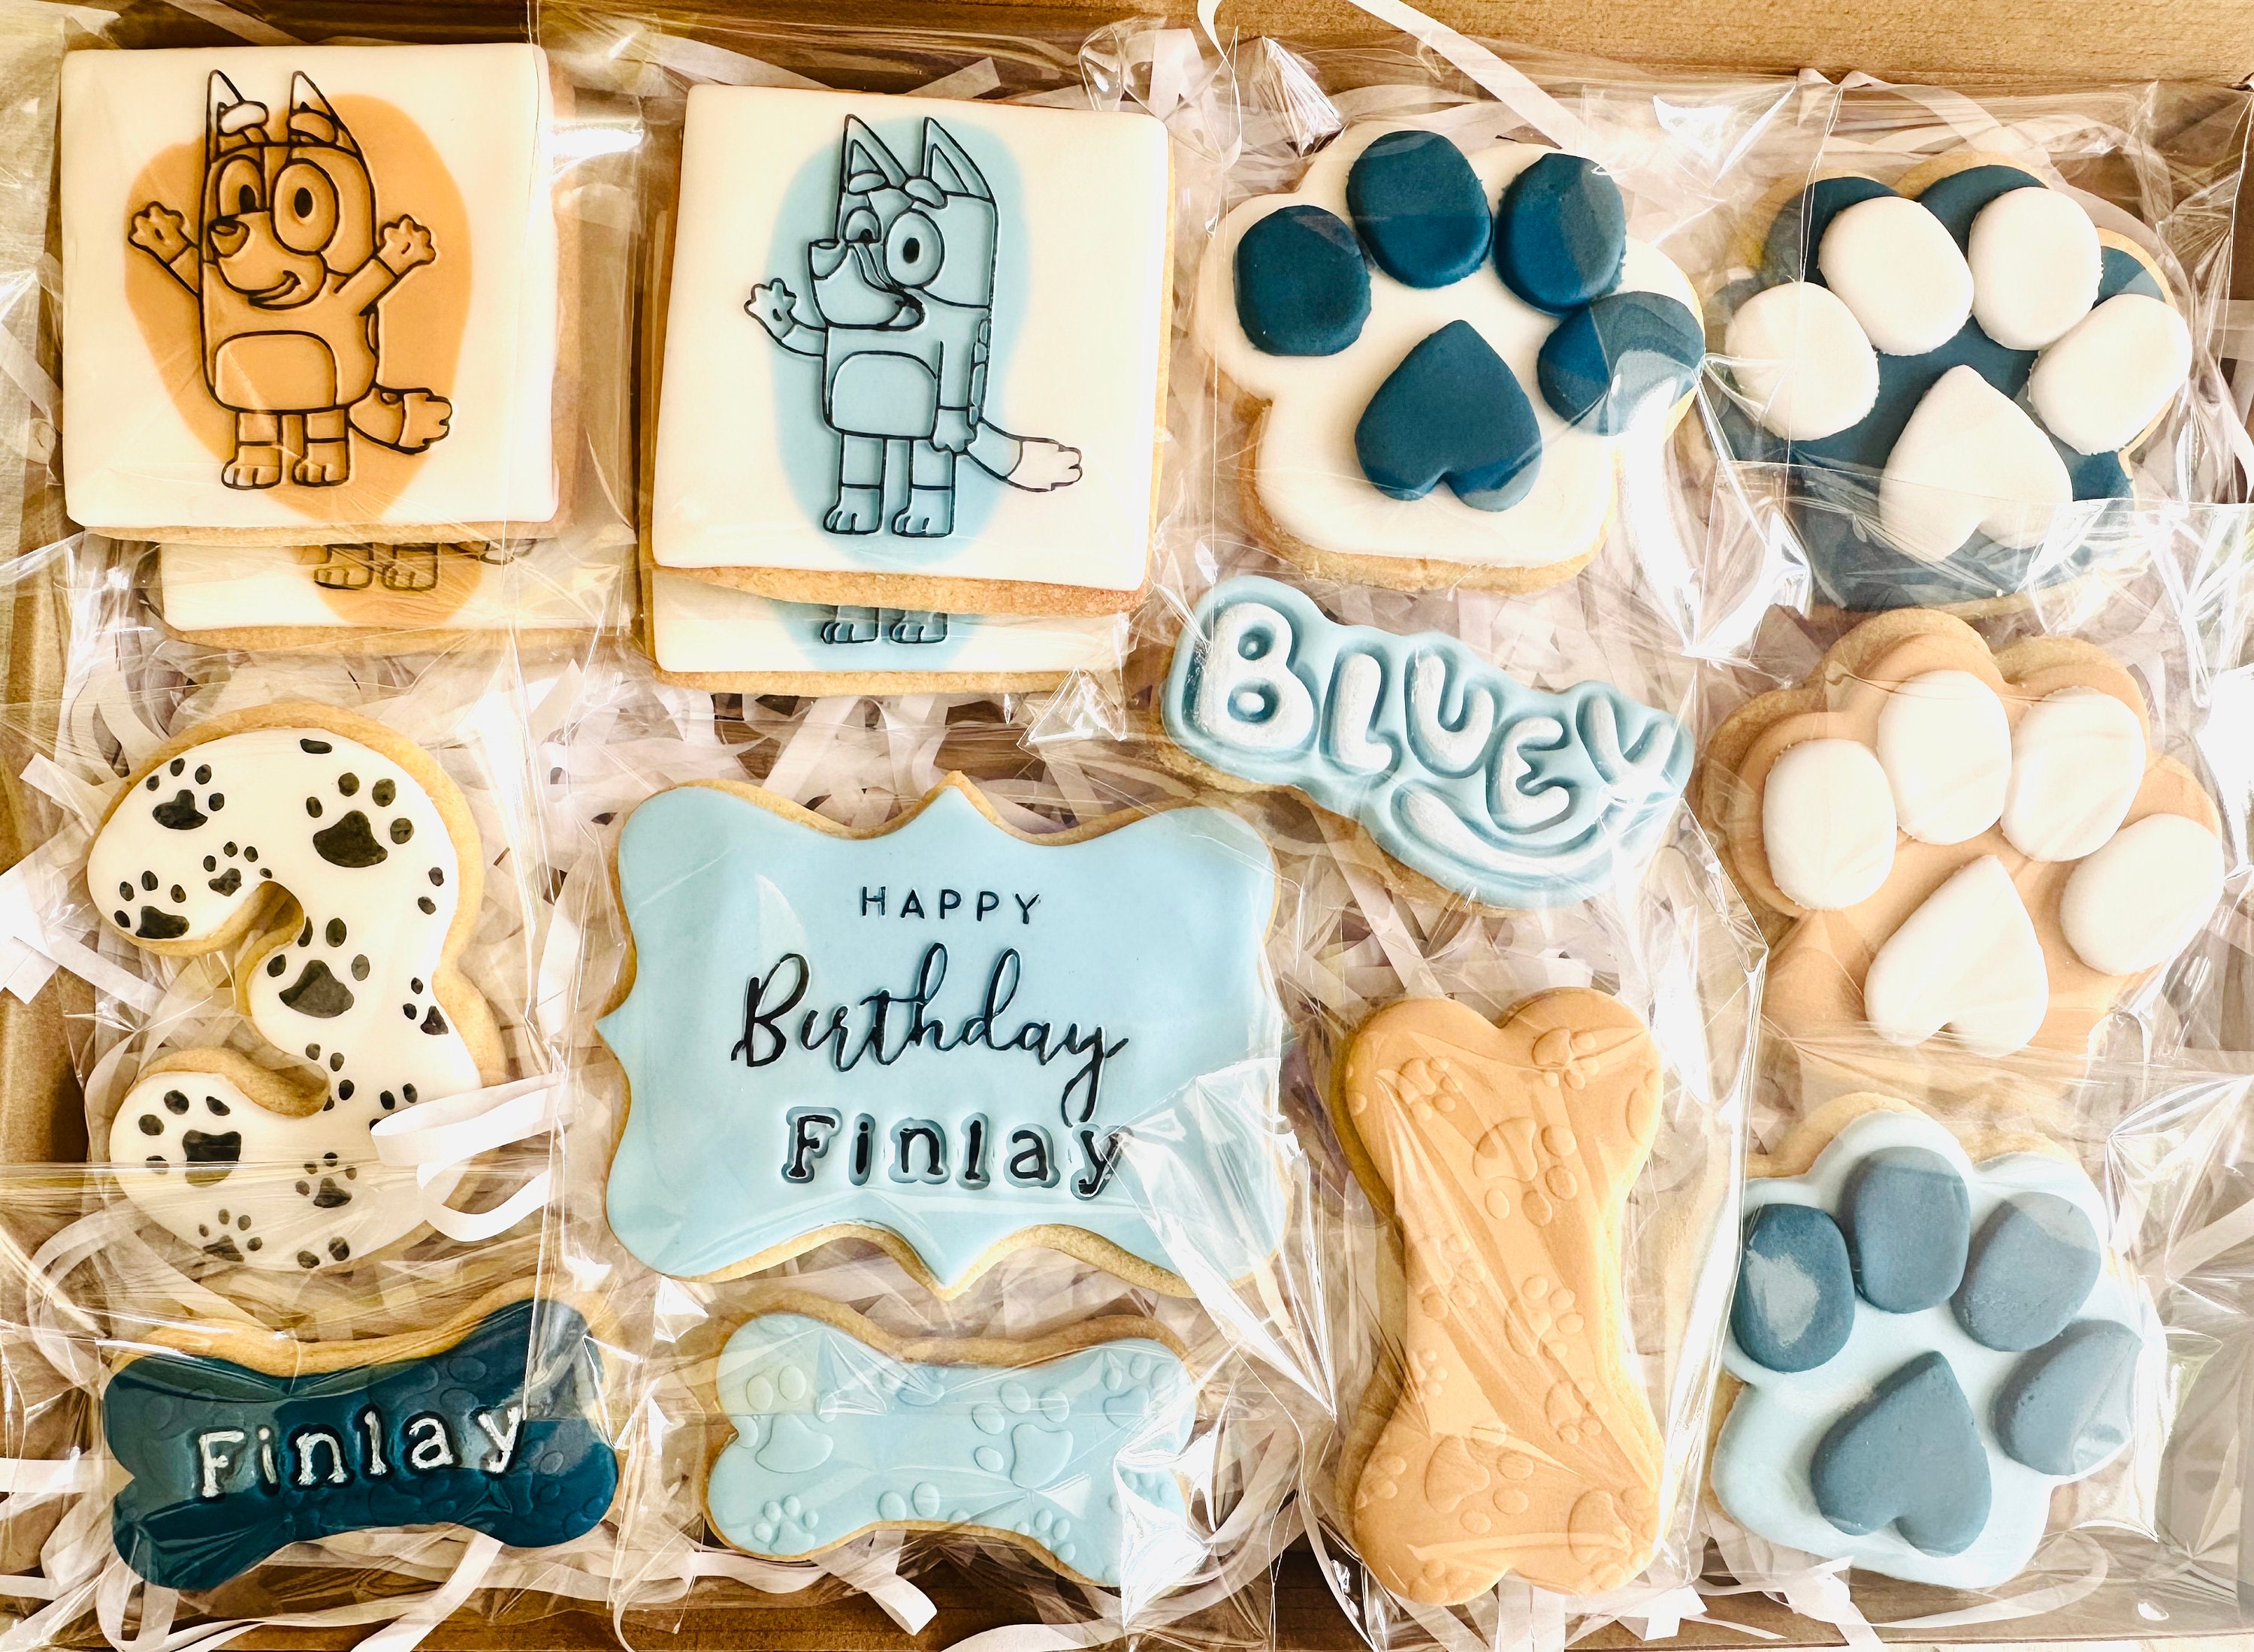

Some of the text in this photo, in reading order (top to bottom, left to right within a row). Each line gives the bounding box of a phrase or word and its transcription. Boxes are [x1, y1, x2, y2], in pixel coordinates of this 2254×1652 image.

[1187, 601, 1680, 875] BLUEY
[860, 886, 1040, 924] HAPPY
[730, 942, 1129, 1128] Birthday
[784, 1110, 1129, 1199] Finlay
[198, 1406, 523, 1498] Finlay
